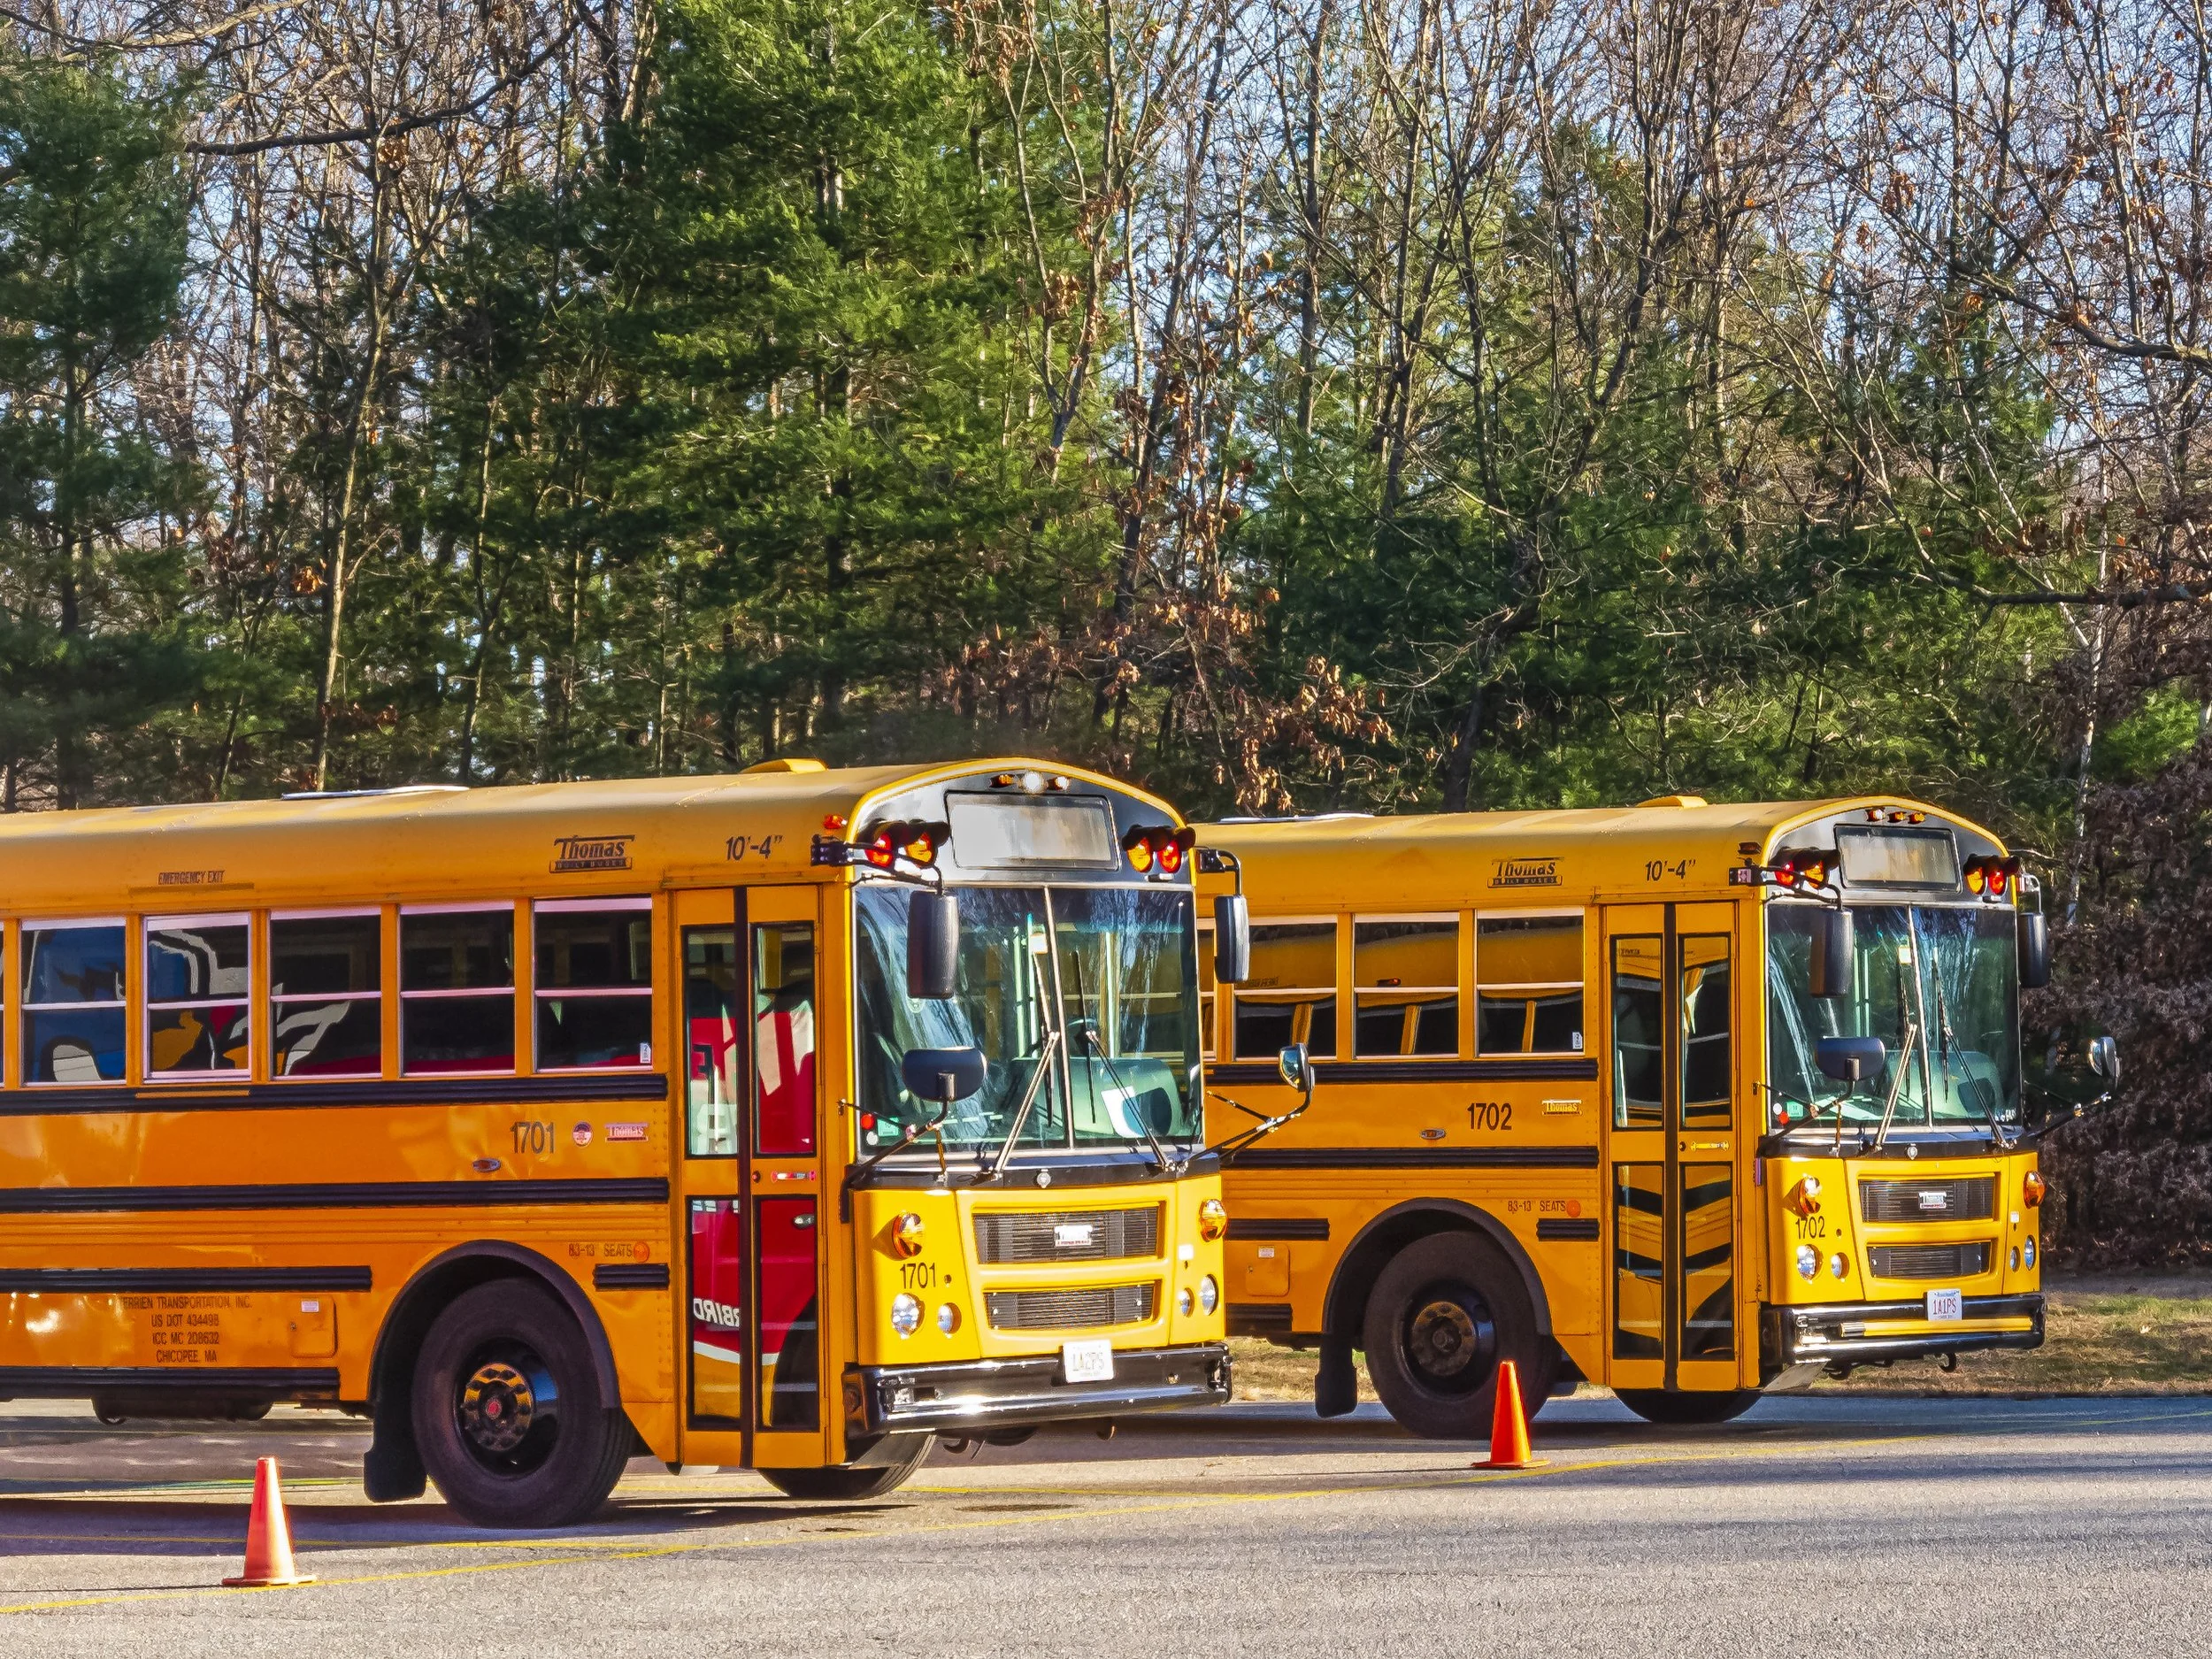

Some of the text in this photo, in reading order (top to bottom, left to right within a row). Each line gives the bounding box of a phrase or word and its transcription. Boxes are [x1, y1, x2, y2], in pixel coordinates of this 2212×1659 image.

[554, 835, 635, 859] Thomas
[1491, 856, 1564, 876] Thomas
[158, 870, 225, 885] EMERGENCY EXIT
[1467, 1102, 1512, 1131] 1702
[510, 1120, 554, 1154] 1701
[1540, 1200, 1565, 1212] SEATS
[1795, 1216, 1825, 1240] 1702
[603, 1243, 633, 1256] SEATS
[900, 1262, 935, 1289] 1701
[151, 1314, 163, 1327] US
[166, 1314, 183, 1327] DOT
[152, 1332, 167, 1345] ICC
[171, 1332, 184, 1345] MC
[204, 1349, 218, 1363] MA
